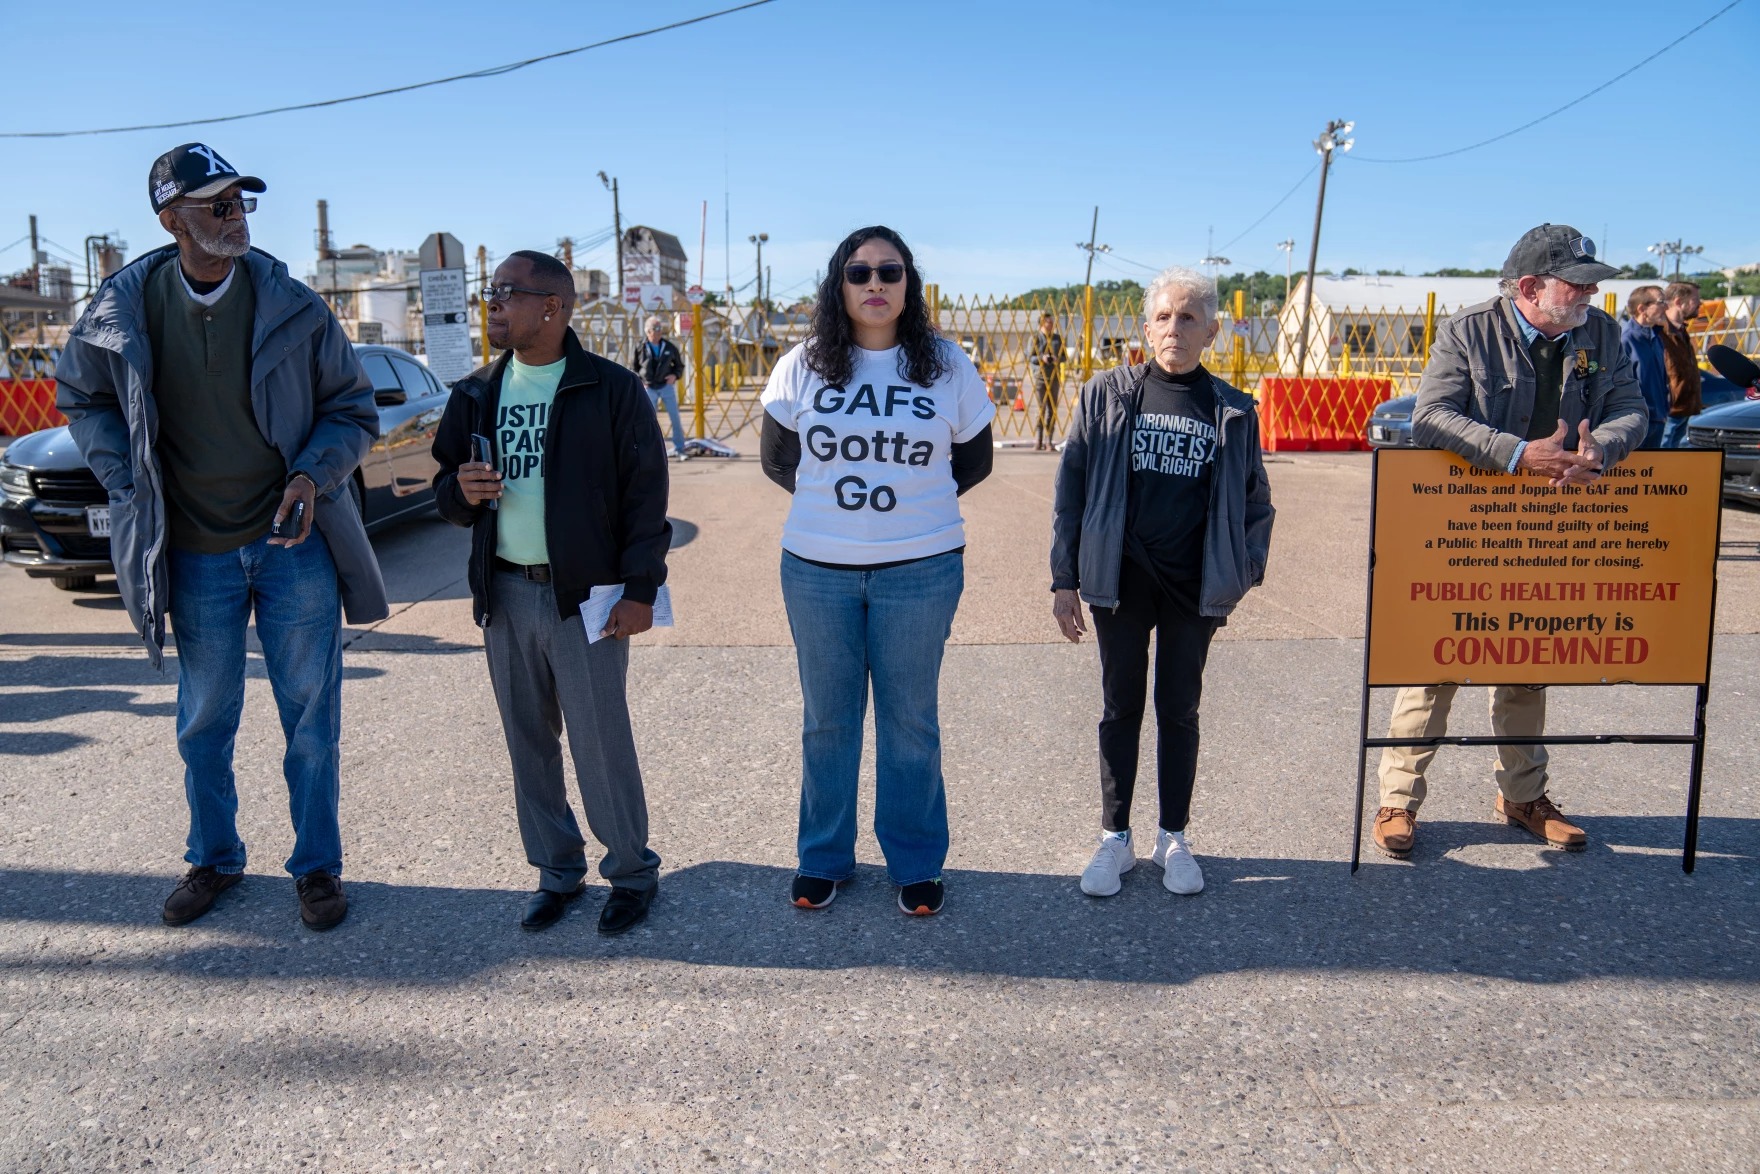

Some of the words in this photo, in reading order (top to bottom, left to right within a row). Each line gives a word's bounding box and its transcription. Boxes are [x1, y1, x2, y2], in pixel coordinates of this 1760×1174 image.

[188, 145, 235, 176] X
[812, 384, 937, 420] GAFs
[496, 402, 553, 430] USTI
[806, 424, 934, 467] Gotta
[1187, 435, 1207, 461] IS
[500, 453, 545, 481] JOP
[1132, 452, 1159, 472] CIVIL
[1160, 455, 1203, 478] RIGHT
[1449, 465, 1466, 478] By
[1641, 466, 1655, 478] of
[834, 475, 897, 512] Go
[1412, 483, 1443, 495] West
[1447, 483, 1487, 495] Dallas
[1491, 484, 1516, 495] and
[1519, 484, 1557, 498] Joppa
[1561, 484, 1582, 496] the
[1586, 484, 1611, 496] GAF
[1614, 484, 1638, 496] and
[1643, 484, 1688, 496] TAMKO
[1470, 502, 1518, 515] asphalt
[1521, 502, 1568, 516] shingle
[1572, 502, 1629, 514] factories
[1447, 520, 1477, 531] have
[1481, 520, 1512, 531] been
[1516, 520, 1553, 531] found
[1557, 520, 1593, 533] guilty
[1597, 520, 1610, 532] of
[1613, 520, 1649, 533] being
[1424, 540, 1433, 549] a
[1437, 538, 1477, 549] Public
[1481, 538, 1523, 549] Health
[1527, 538, 1569, 549] Threat
[1572, 538, 1596, 549] and
[1600, 540, 1622, 549] are
[1626, 538, 1670, 551] hereby
[1448, 556, 1499, 567] ordered
[1503, 556, 1567, 567] scheduled
[1571, 556, 1591, 567] for
[1594, 556, 1644, 569] closing.
[1410, 582, 1492, 601] PUBLIC
[1500, 582, 1586, 601] HEALTH
[1593, 582, 1681, 601] THREAT
[1452, 612, 1500, 631] This
[1508, 612, 1607, 635] Property
[1615, 612, 1634, 631] is
[1433, 636, 1649, 665] CONDEMNED
